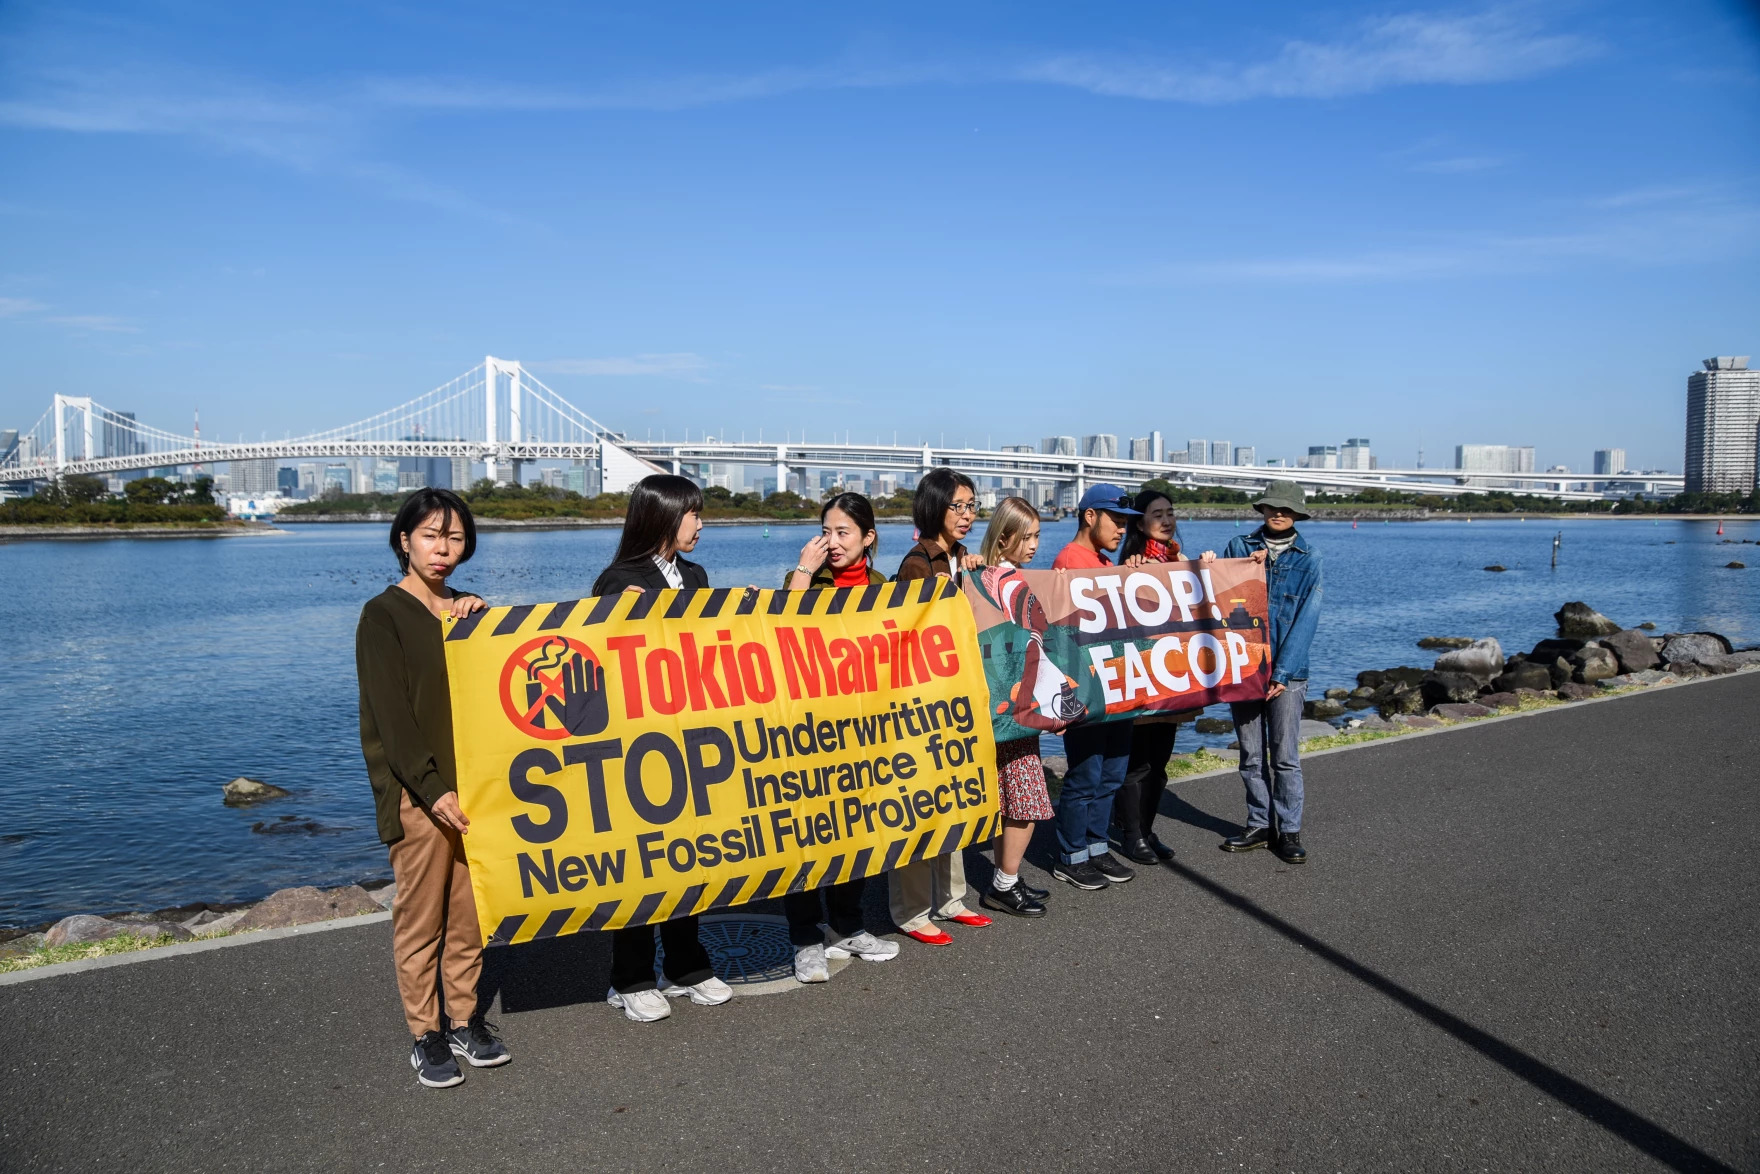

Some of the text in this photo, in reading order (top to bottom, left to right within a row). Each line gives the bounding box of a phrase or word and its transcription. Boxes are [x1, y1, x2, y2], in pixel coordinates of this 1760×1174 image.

[1070, 569, 1222, 633] STOP!
[606, 619, 960, 720] Tokio Marine
[1088, 631, 1250, 705] EACOP
[509, 697, 975, 844] STOP Underwriting
[743, 732, 978, 808] Insurance for
[516, 767, 988, 899] New Fossil Fuel Projects!
